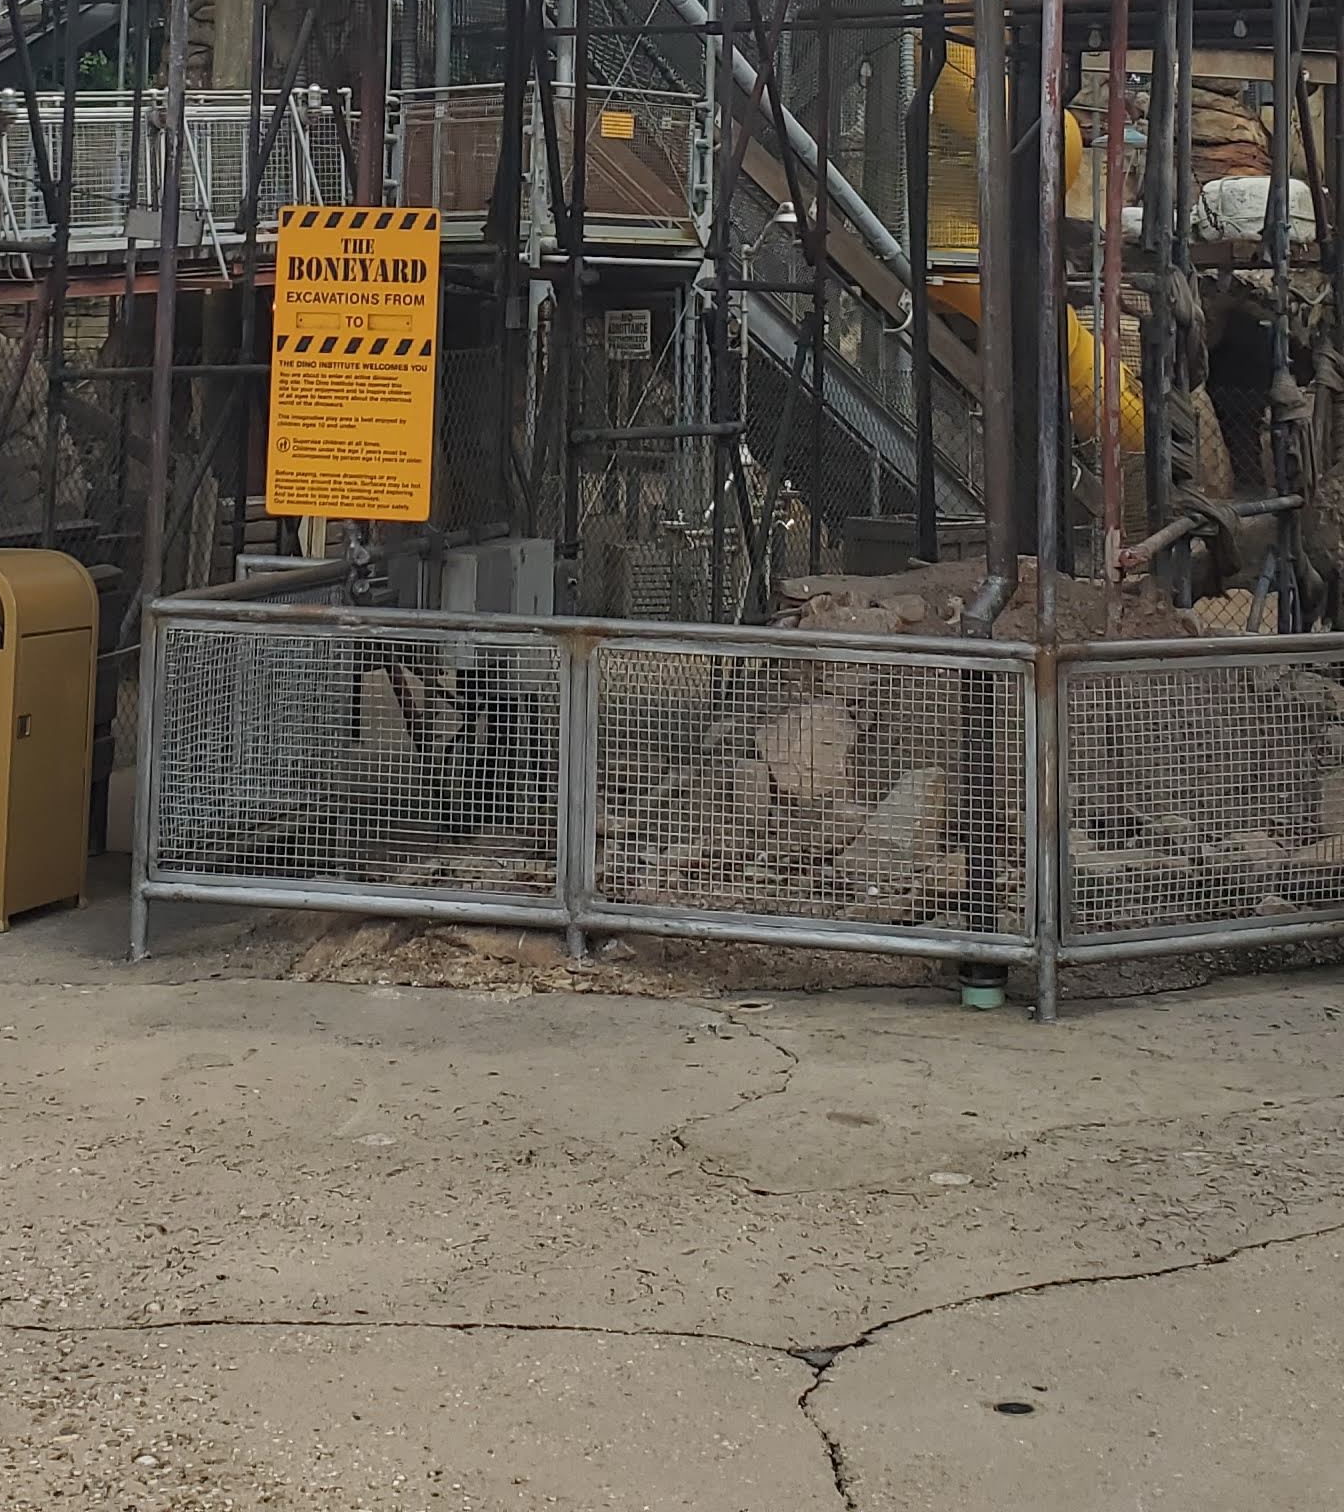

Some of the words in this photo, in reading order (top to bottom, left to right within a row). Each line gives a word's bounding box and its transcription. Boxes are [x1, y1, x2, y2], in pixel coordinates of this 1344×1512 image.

[340, 238, 375, 255] THE
[287, 256, 428, 284] BONEYARD
[286, 291, 380, 305] EXCAVATIONS
[384, 293, 425, 306] FROM
[346, 315, 364, 328] TO
